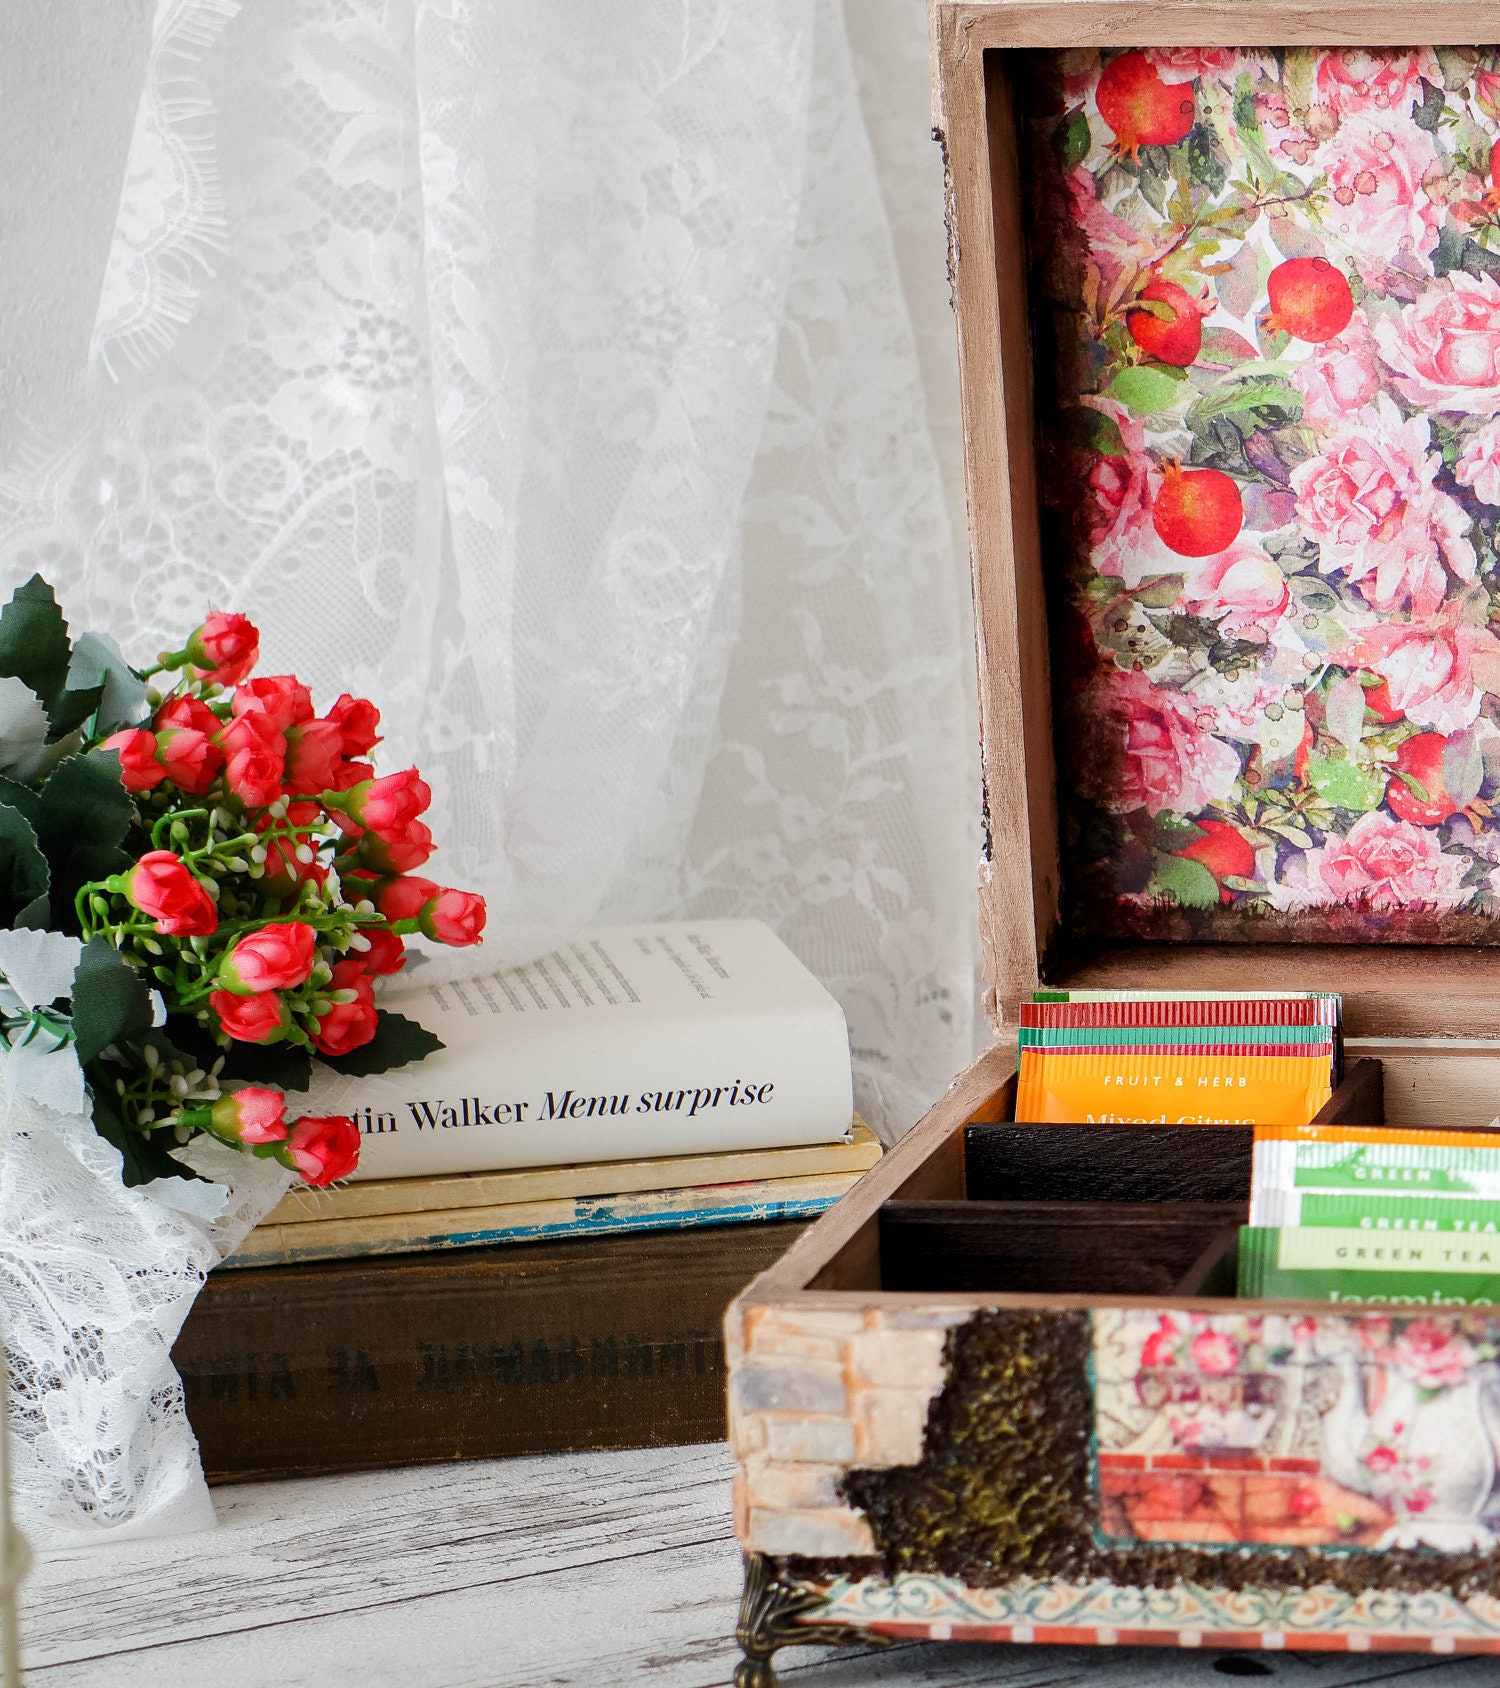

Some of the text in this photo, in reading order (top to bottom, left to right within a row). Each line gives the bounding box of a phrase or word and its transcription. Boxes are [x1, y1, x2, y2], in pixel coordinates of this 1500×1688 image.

[1104, 1076, 1247, 1088] FRUIT & HERB
[404, 1097, 529, 1131] Walker
[535, 1090, 630, 1121] Menu
[636, 1079, 775, 1117] surprise
[1354, 1167, 1431, 1181] GREEN
[1360, 1216, 1498, 1233] GREEN TEA
[1335, 1247, 1491, 1262] GREEN TEA
